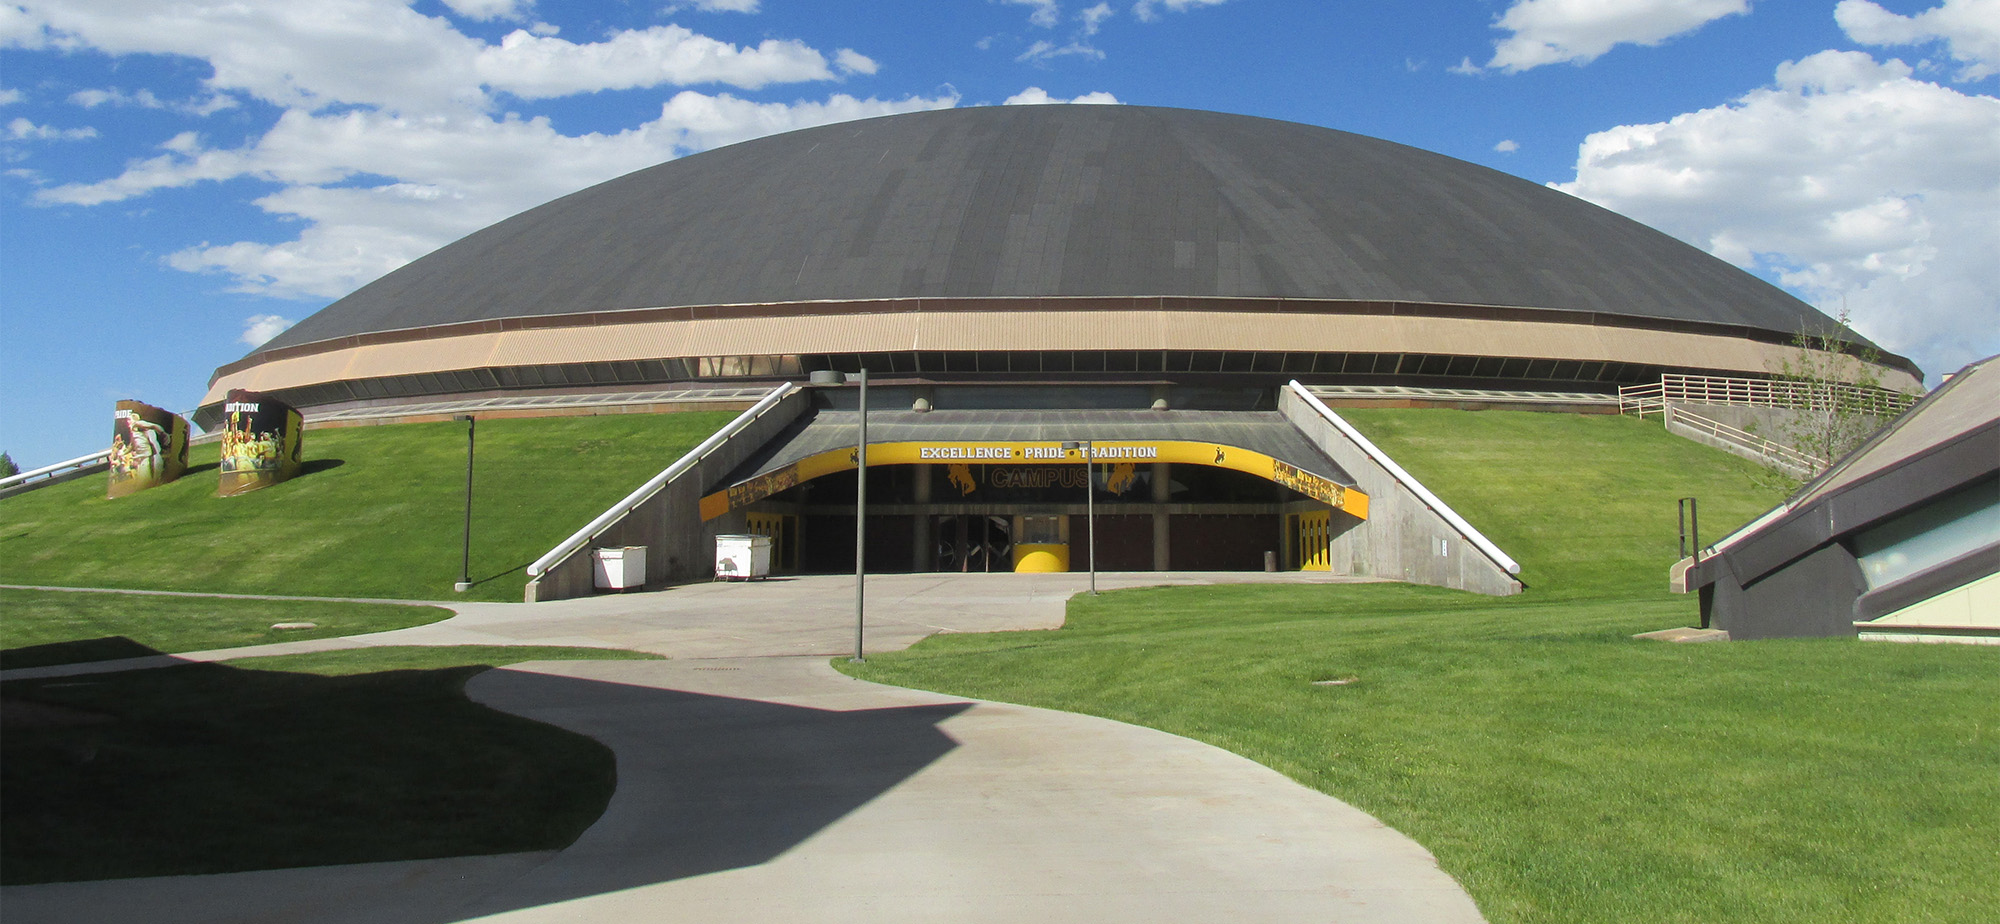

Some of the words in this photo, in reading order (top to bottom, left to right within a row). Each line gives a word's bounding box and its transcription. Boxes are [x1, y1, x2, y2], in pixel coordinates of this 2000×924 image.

[920, 447, 1011, 459] EXCELLENCE
[1024, 447, 1065, 459] PRIDE
[1079, 447, 1157, 459] TRADITION
[991, 467, 1089, 488] CAMPUS
